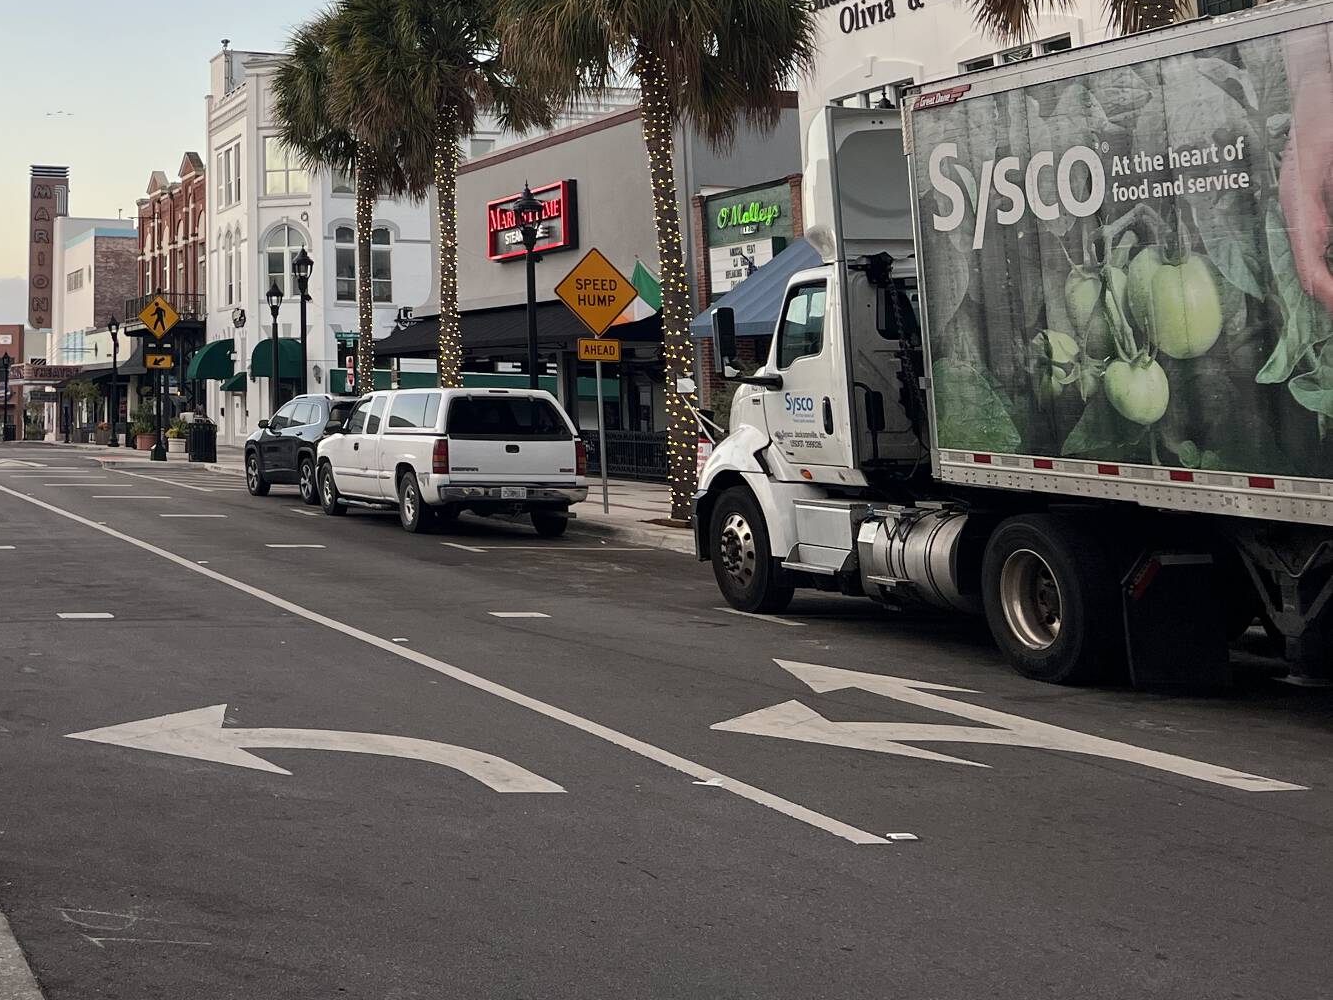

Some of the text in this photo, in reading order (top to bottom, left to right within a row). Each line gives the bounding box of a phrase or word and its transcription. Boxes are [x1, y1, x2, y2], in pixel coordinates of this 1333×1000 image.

[1112, 136, 1245, 177] At the heart of
[1112, 170, 1250, 202] food and service
[32, 184, 51, 312] MARION
[575, 279, 617, 292] SPEED
[578, 294, 616, 307] HUMP
[584, 345, 615, 356] AHEAD
[785, 392, 814, 414] Sysco
